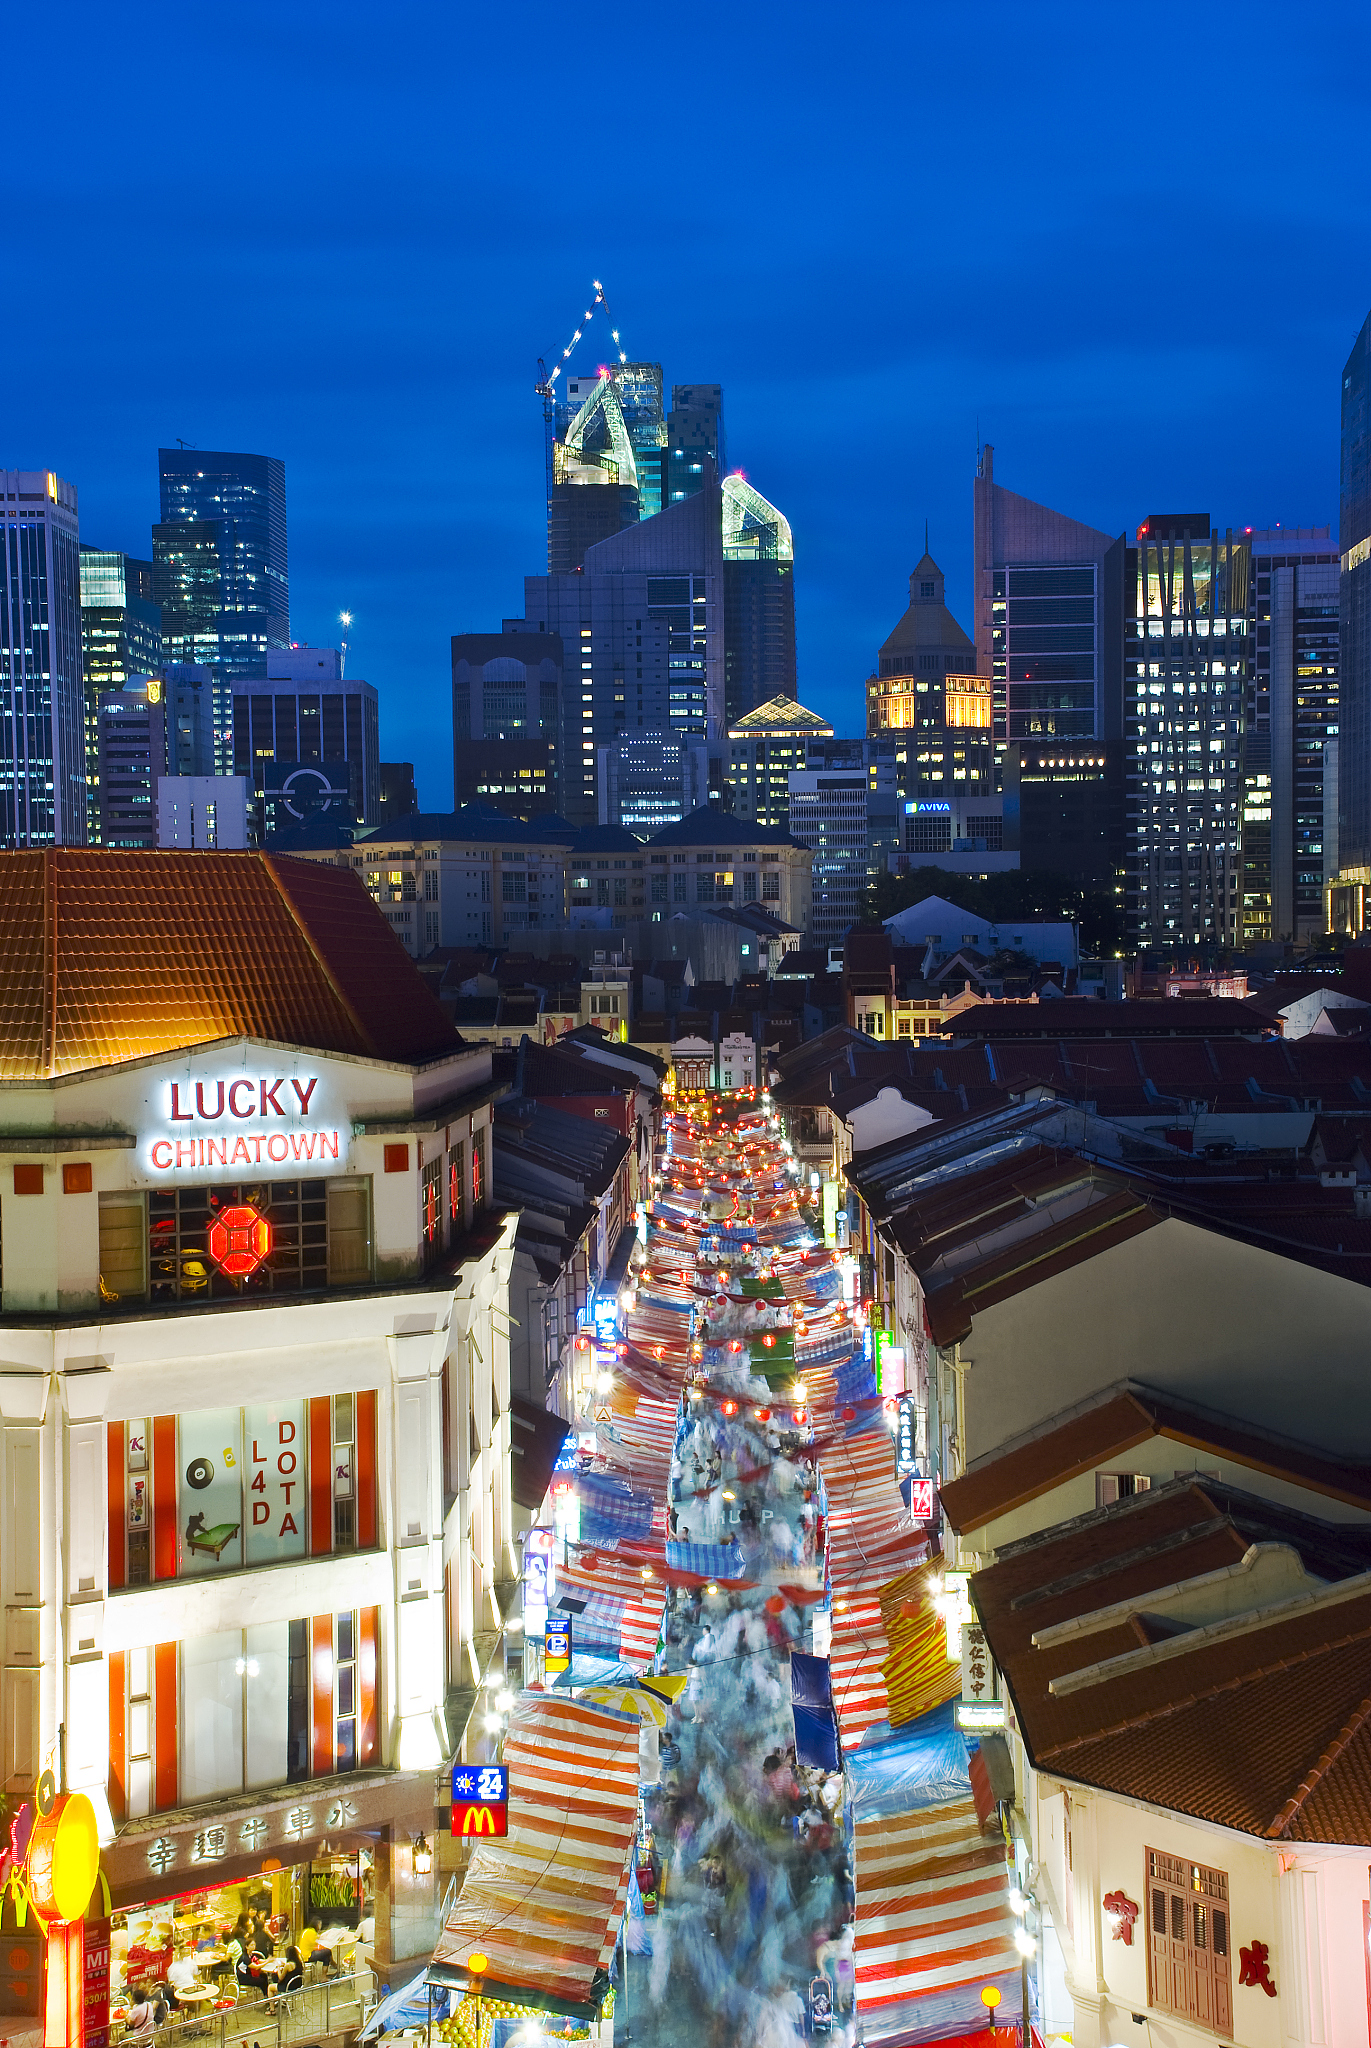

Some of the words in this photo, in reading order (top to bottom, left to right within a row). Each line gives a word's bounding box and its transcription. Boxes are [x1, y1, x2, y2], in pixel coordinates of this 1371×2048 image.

[918, 803, 950, 811] AVIVA
[170, 1077, 318, 1121] LUCKY
[151, 1131, 339, 1169] CHINATOWN
[129, 1436, 145, 1452] K
[250, 1440, 271, 1526] L4D
[277, 1420, 299, 1537] DOTA
[335, 1464, 350, 1479] K
[477, 1774, 504, 1794] 24
